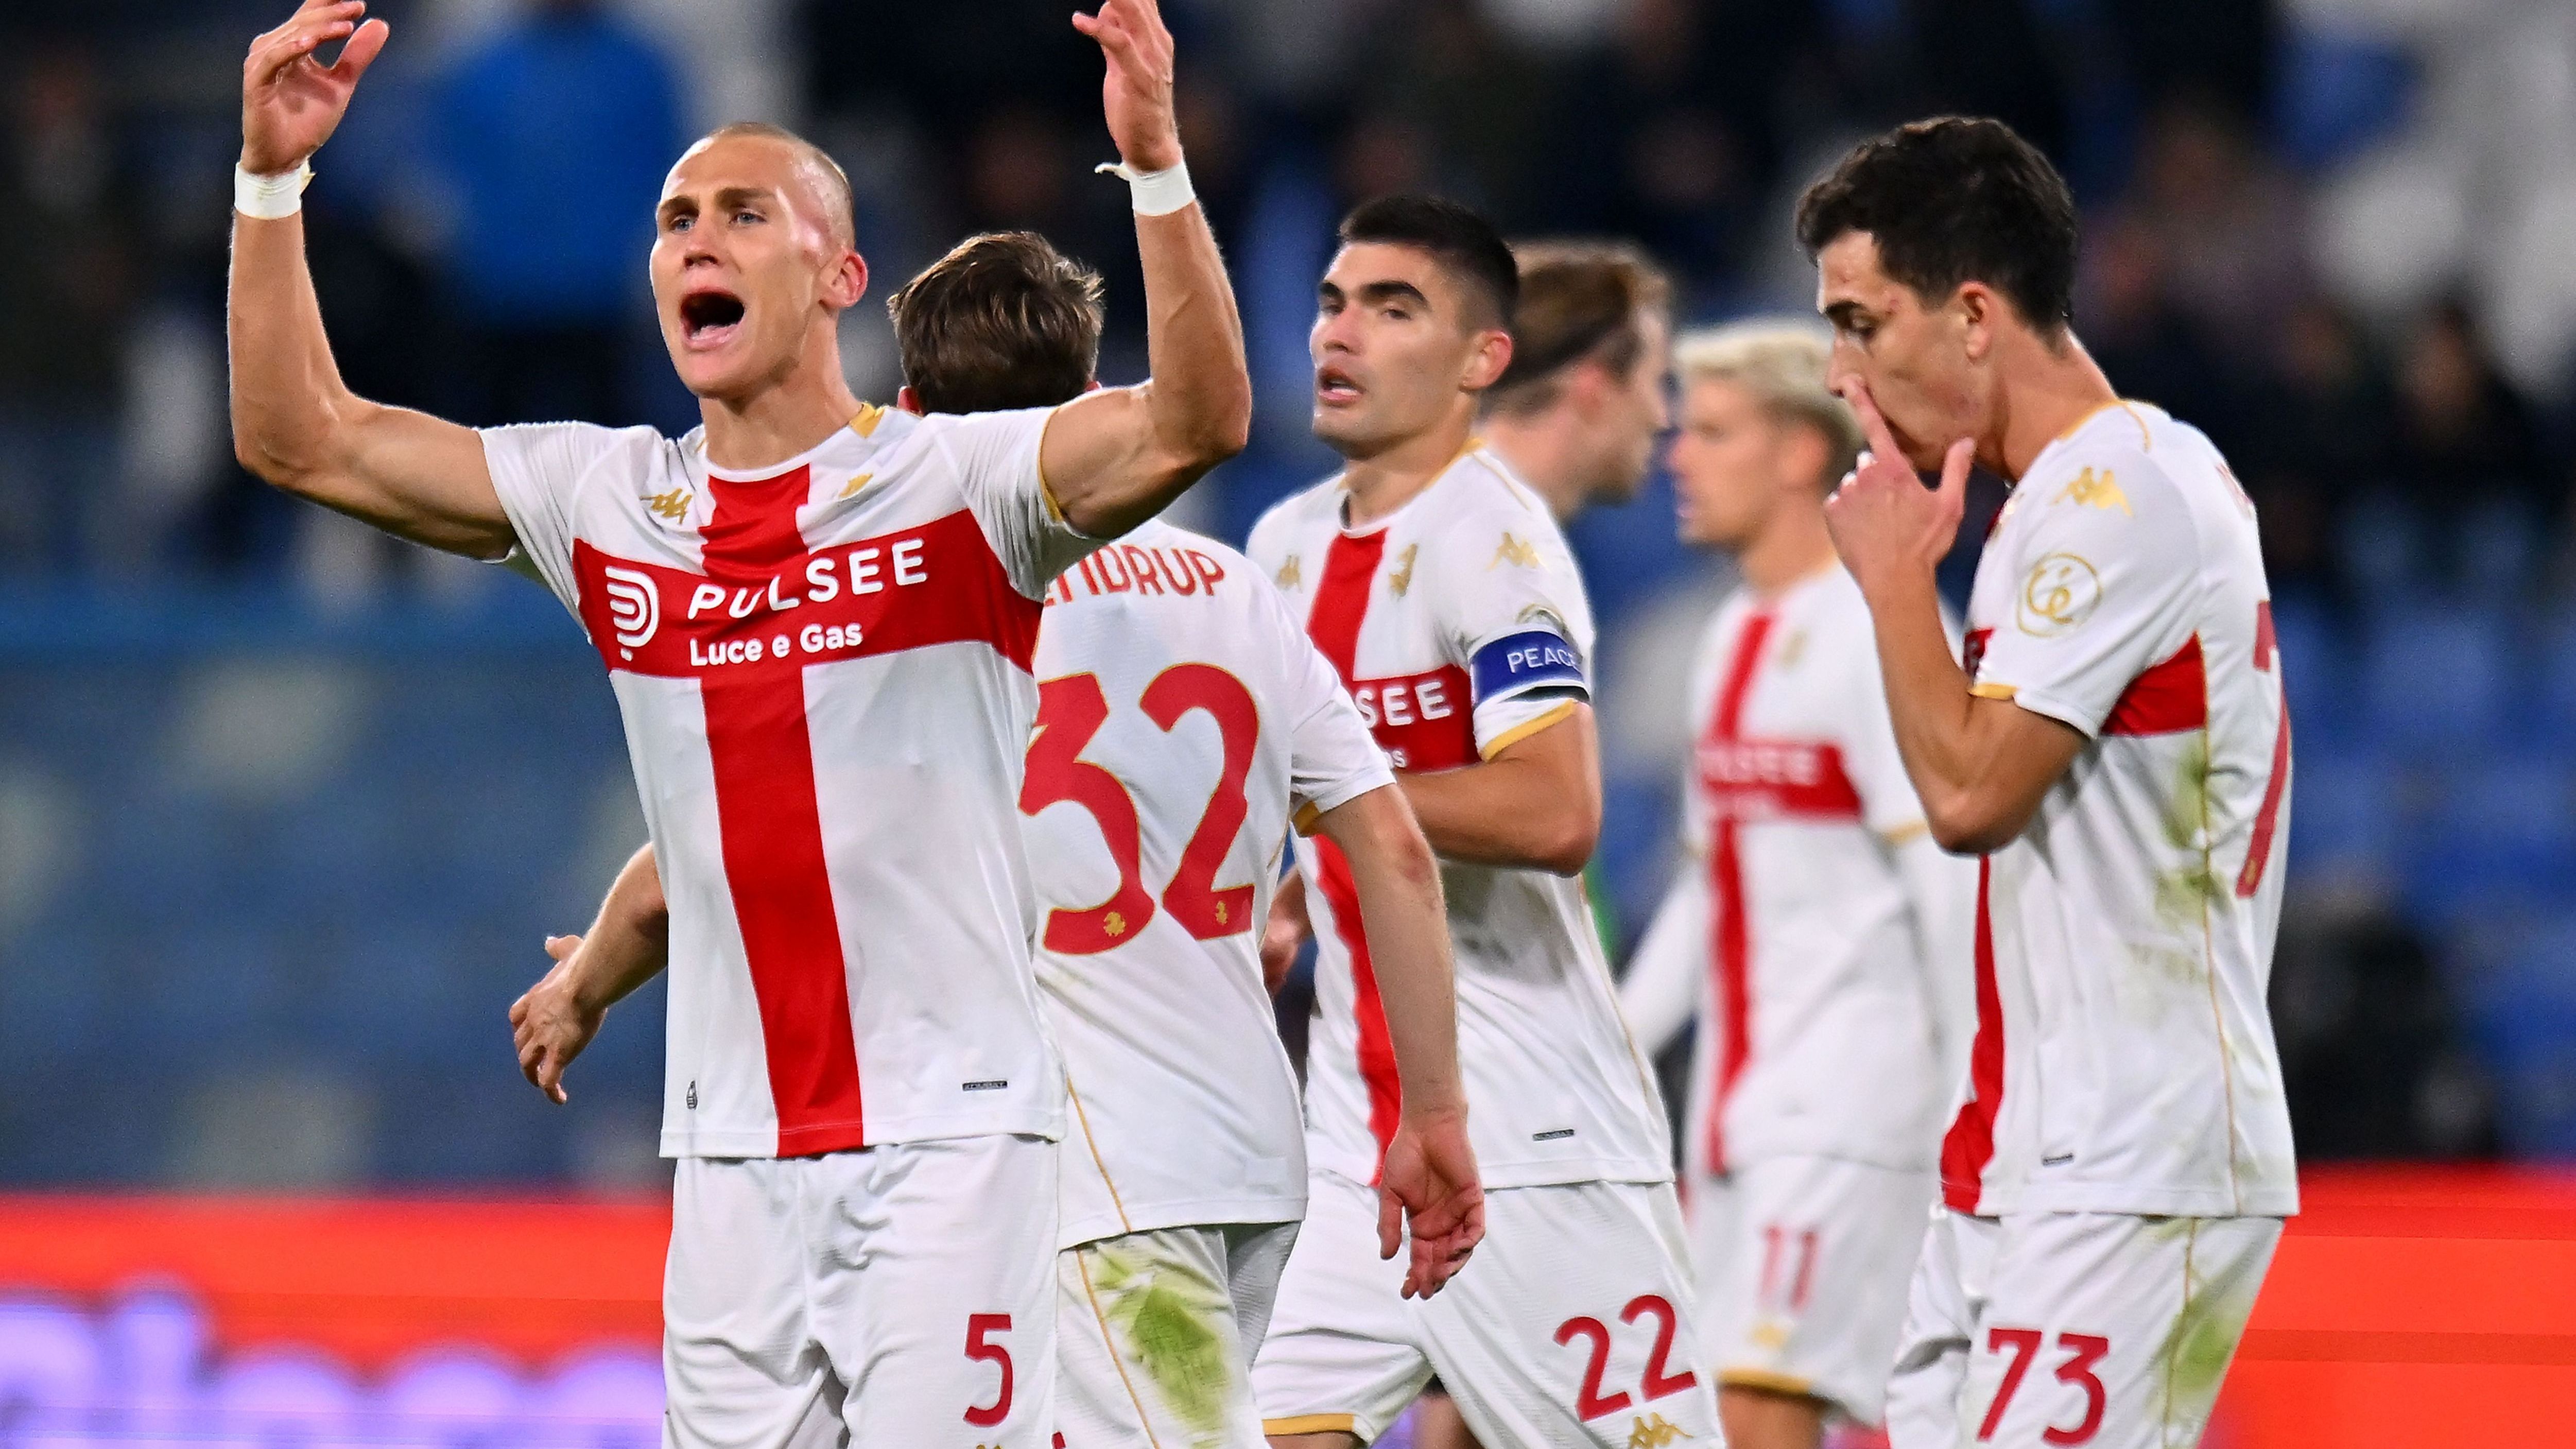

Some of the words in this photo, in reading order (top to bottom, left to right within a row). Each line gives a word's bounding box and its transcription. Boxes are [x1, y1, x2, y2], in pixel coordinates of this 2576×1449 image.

[687, 538, 928, 619] PULSEE
[1044, 544, 1225, 607] NDRUP
[690, 638, 764, 666] Luce
[771, 633, 791, 658] e
[800, 623, 863, 653] Gas
[1507, 647, 1581, 674] PEAC
[1017, 662, 1261, 955] 32
[1753, 1223, 1820, 1315] 11
[963, 1312, 1014, 1428] 5
[1553, 1294, 1698, 1423] 22
[1977, 1327, 2110, 1448] 73
